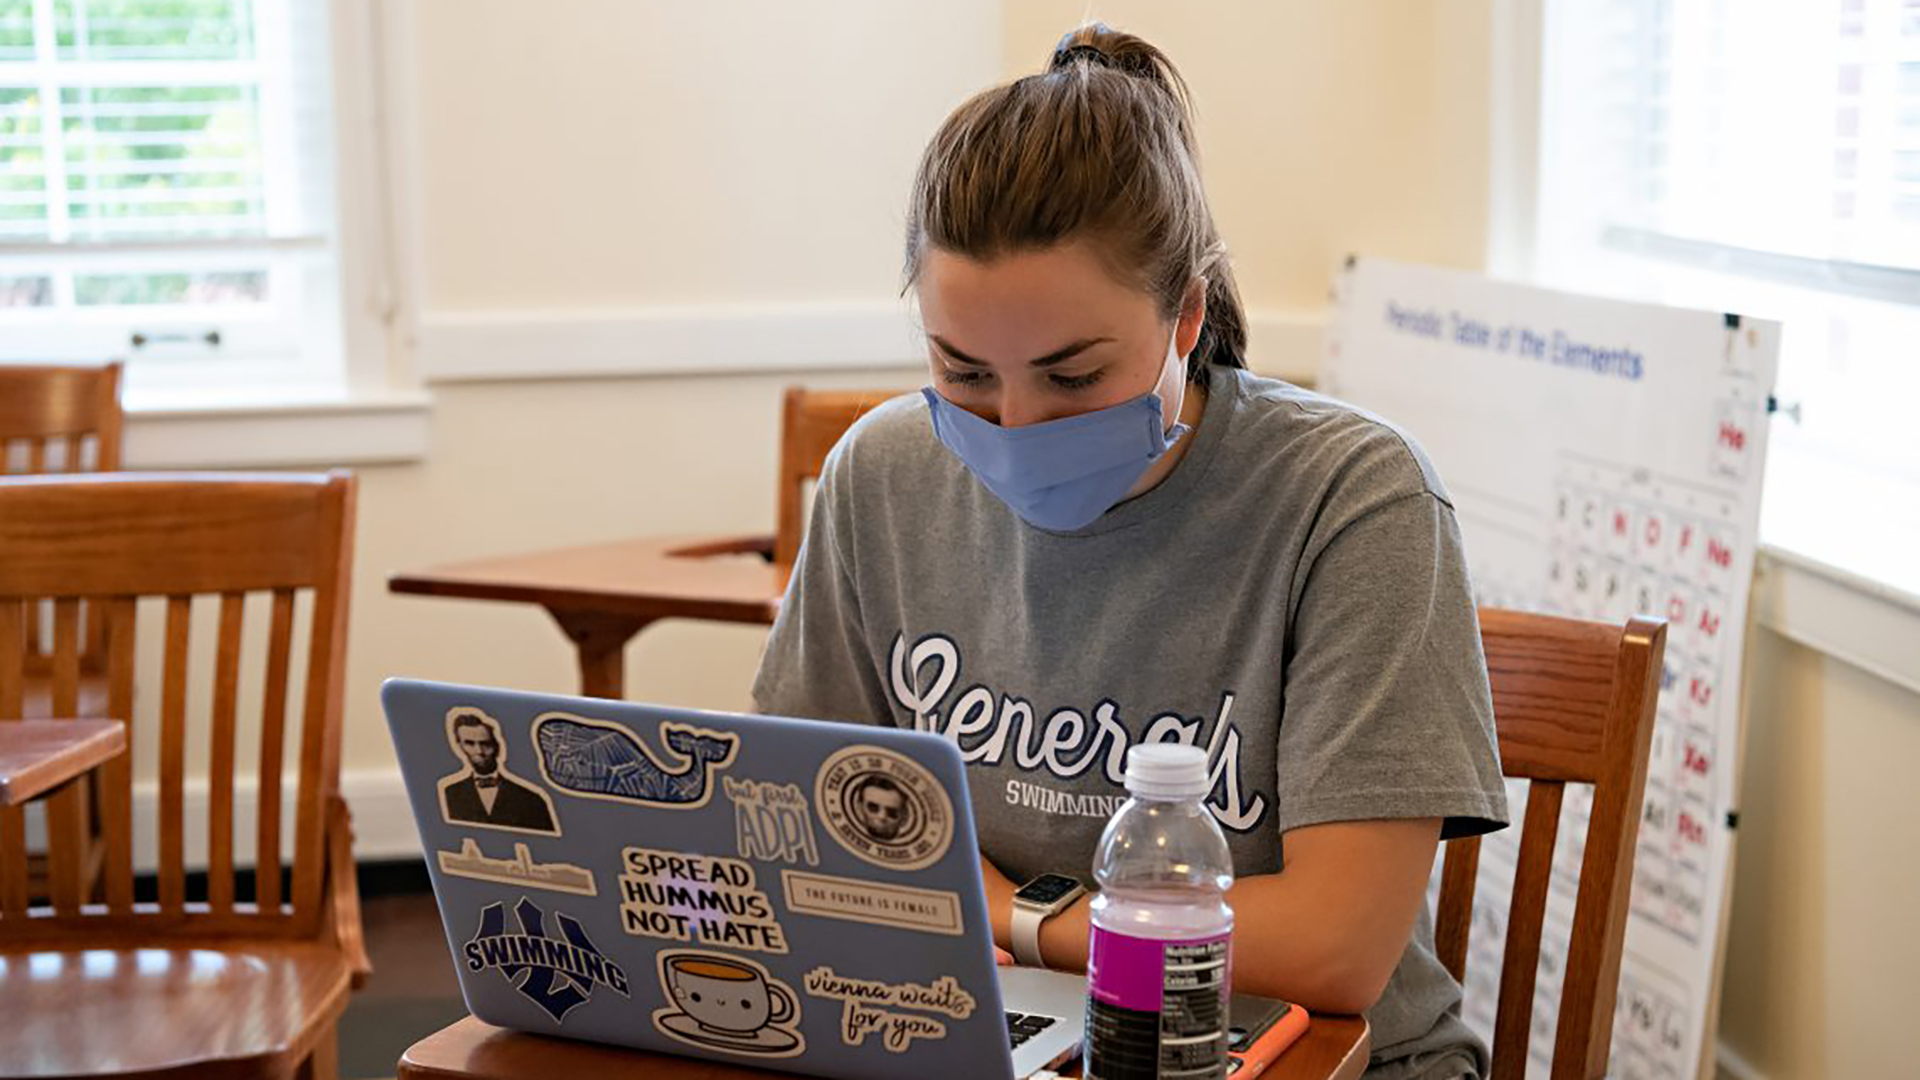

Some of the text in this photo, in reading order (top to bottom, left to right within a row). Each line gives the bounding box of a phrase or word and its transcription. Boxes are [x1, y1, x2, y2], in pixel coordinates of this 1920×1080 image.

[1553, 331, 1644, 380] Elements
[628, 852, 750, 887] SPREAD
[625, 880, 768, 918] HUMMUS
[805, 888, 938, 916] THE FUTURE IS FEMALE
[626, 909, 782, 949] NOT HATE
[464, 935, 631, 998] SWIMMING
[809, 972, 966, 1014] vienna waits
[848, 1004, 939, 1047] for you
